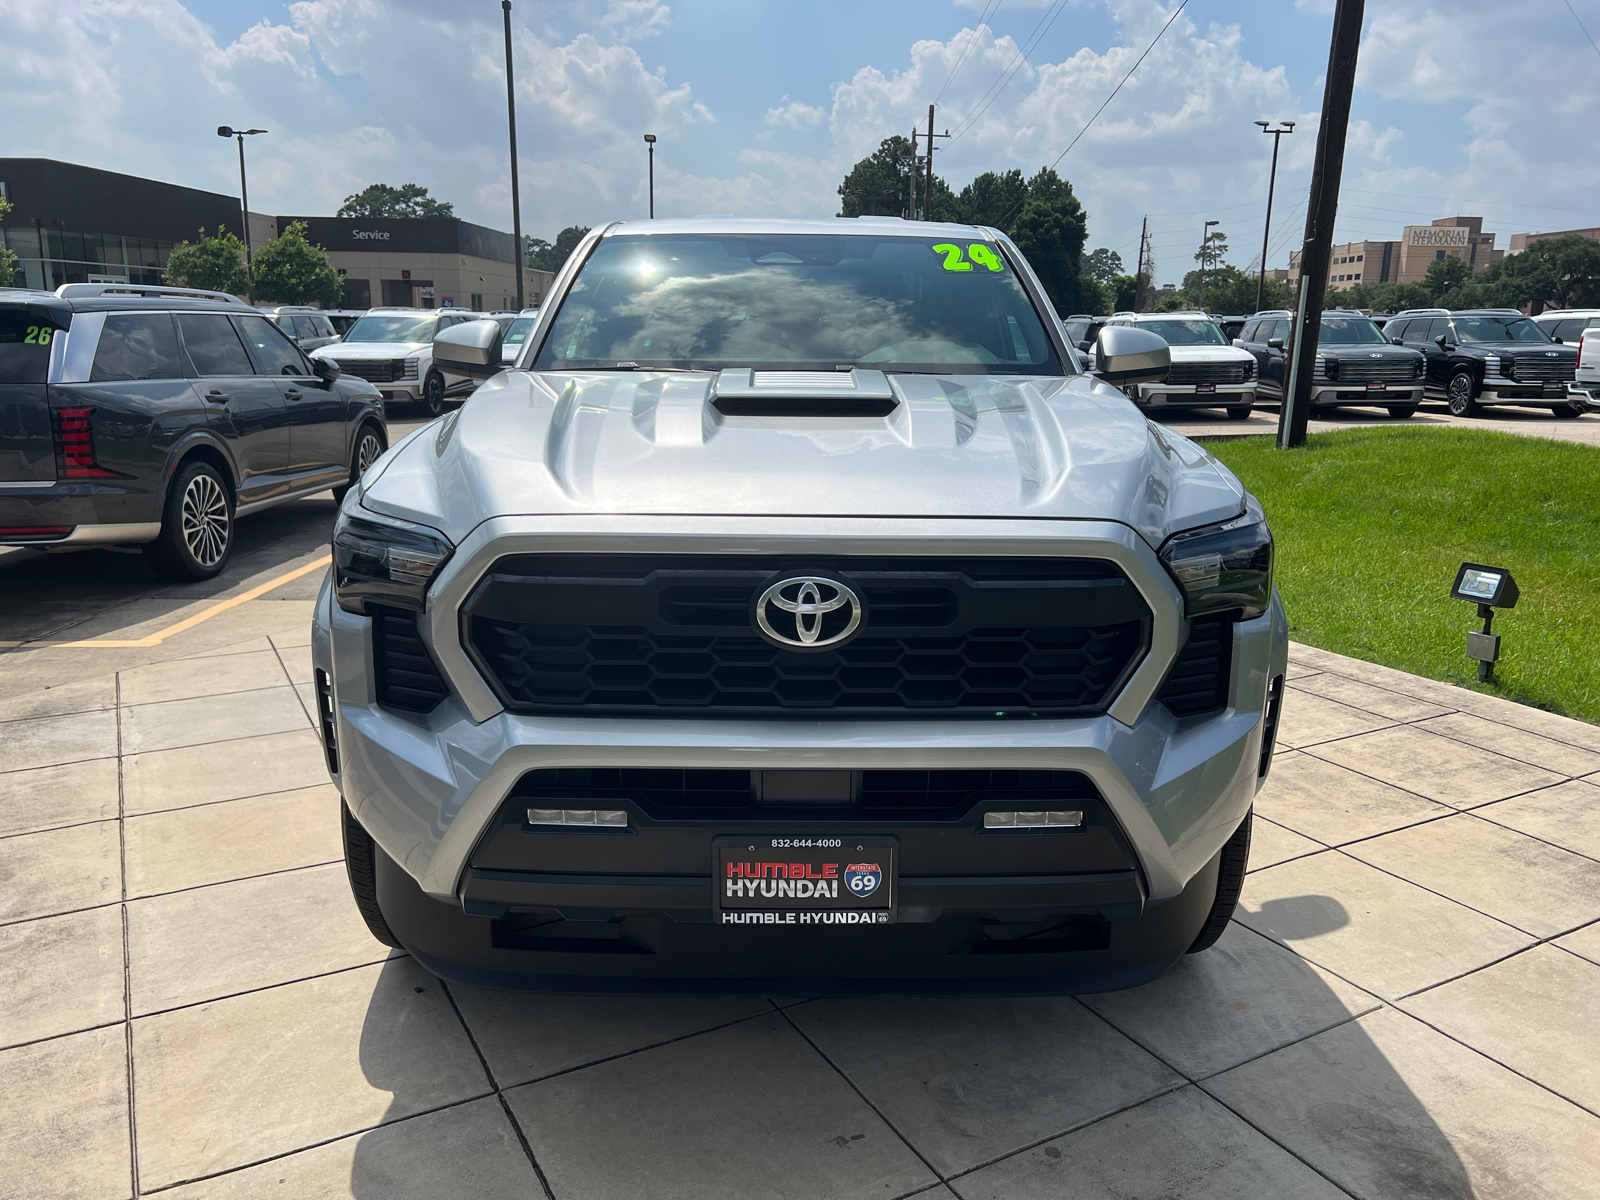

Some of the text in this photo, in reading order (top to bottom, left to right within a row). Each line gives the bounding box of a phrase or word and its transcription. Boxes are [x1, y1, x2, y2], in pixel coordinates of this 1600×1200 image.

[352, 229, 390, 240] Service
[1412, 229, 1466, 239] MEMORIAL
[1412, 237, 1466, 246] HERMANN
[932, 243, 1004, 272] 24
[24, 325, 52, 345] 26
[771, 839, 841, 848] 832-644-4000
[726, 862, 838, 879] HUMBLE
[726, 879, 838, 898] HYUNDAI
[850, 875, 876, 891] 69
[722, 912, 796, 924] HUMBLE
[800, 912, 876, 924] HYUNDAI
